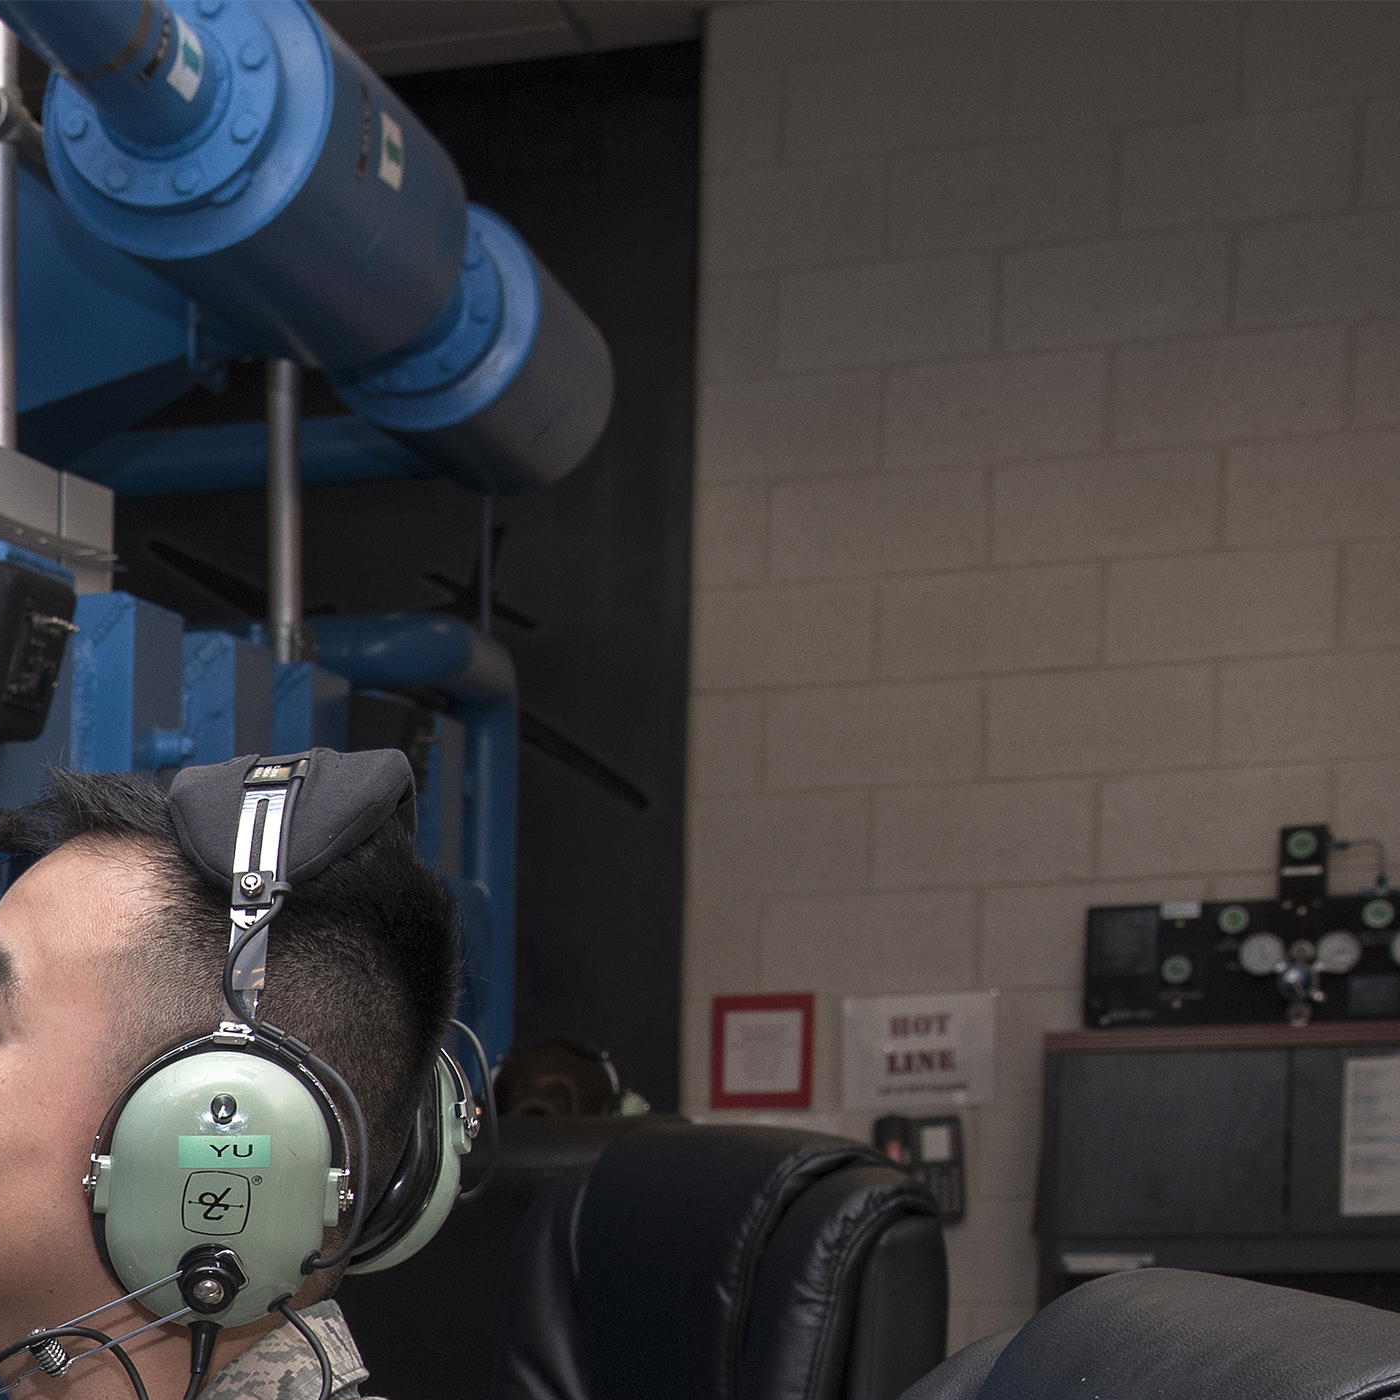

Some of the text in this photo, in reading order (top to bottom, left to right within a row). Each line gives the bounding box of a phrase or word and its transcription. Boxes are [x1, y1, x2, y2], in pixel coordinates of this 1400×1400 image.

[889, 1013, 951, 1039] HOT
[886, 1051, 956, 1076] LINE
[209, 1143, 255, 1159] YU
